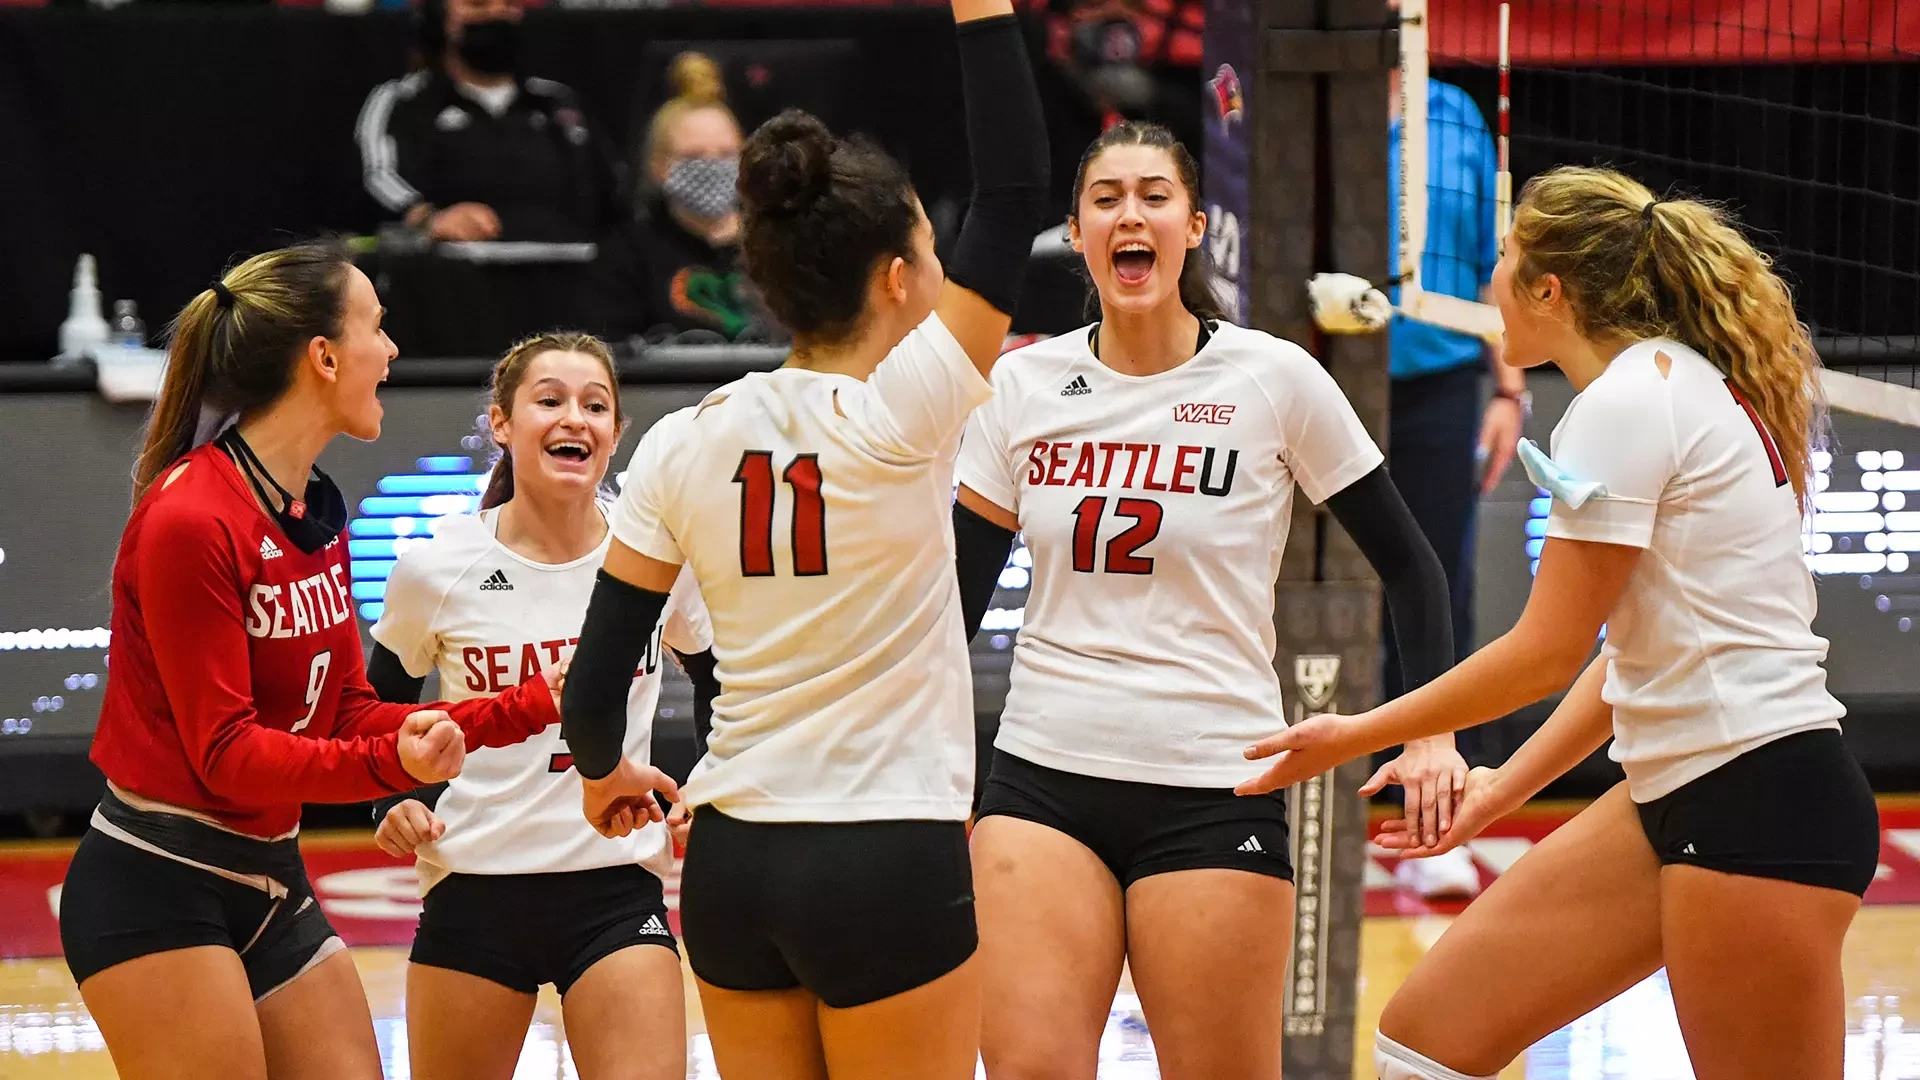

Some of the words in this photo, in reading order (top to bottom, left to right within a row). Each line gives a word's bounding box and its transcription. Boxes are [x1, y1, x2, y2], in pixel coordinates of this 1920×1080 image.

[1060, 387, 1092, 396] adidas
[1172, 403, 1236, 425] WAC
[730, 449, 829, 577] 11
[1071, 495, 1164, 575] 12
[246, 562, 350, 639] SEATTLE
[479, 582, 514, 591] adidas
[289, 650, 331, 733] 9
